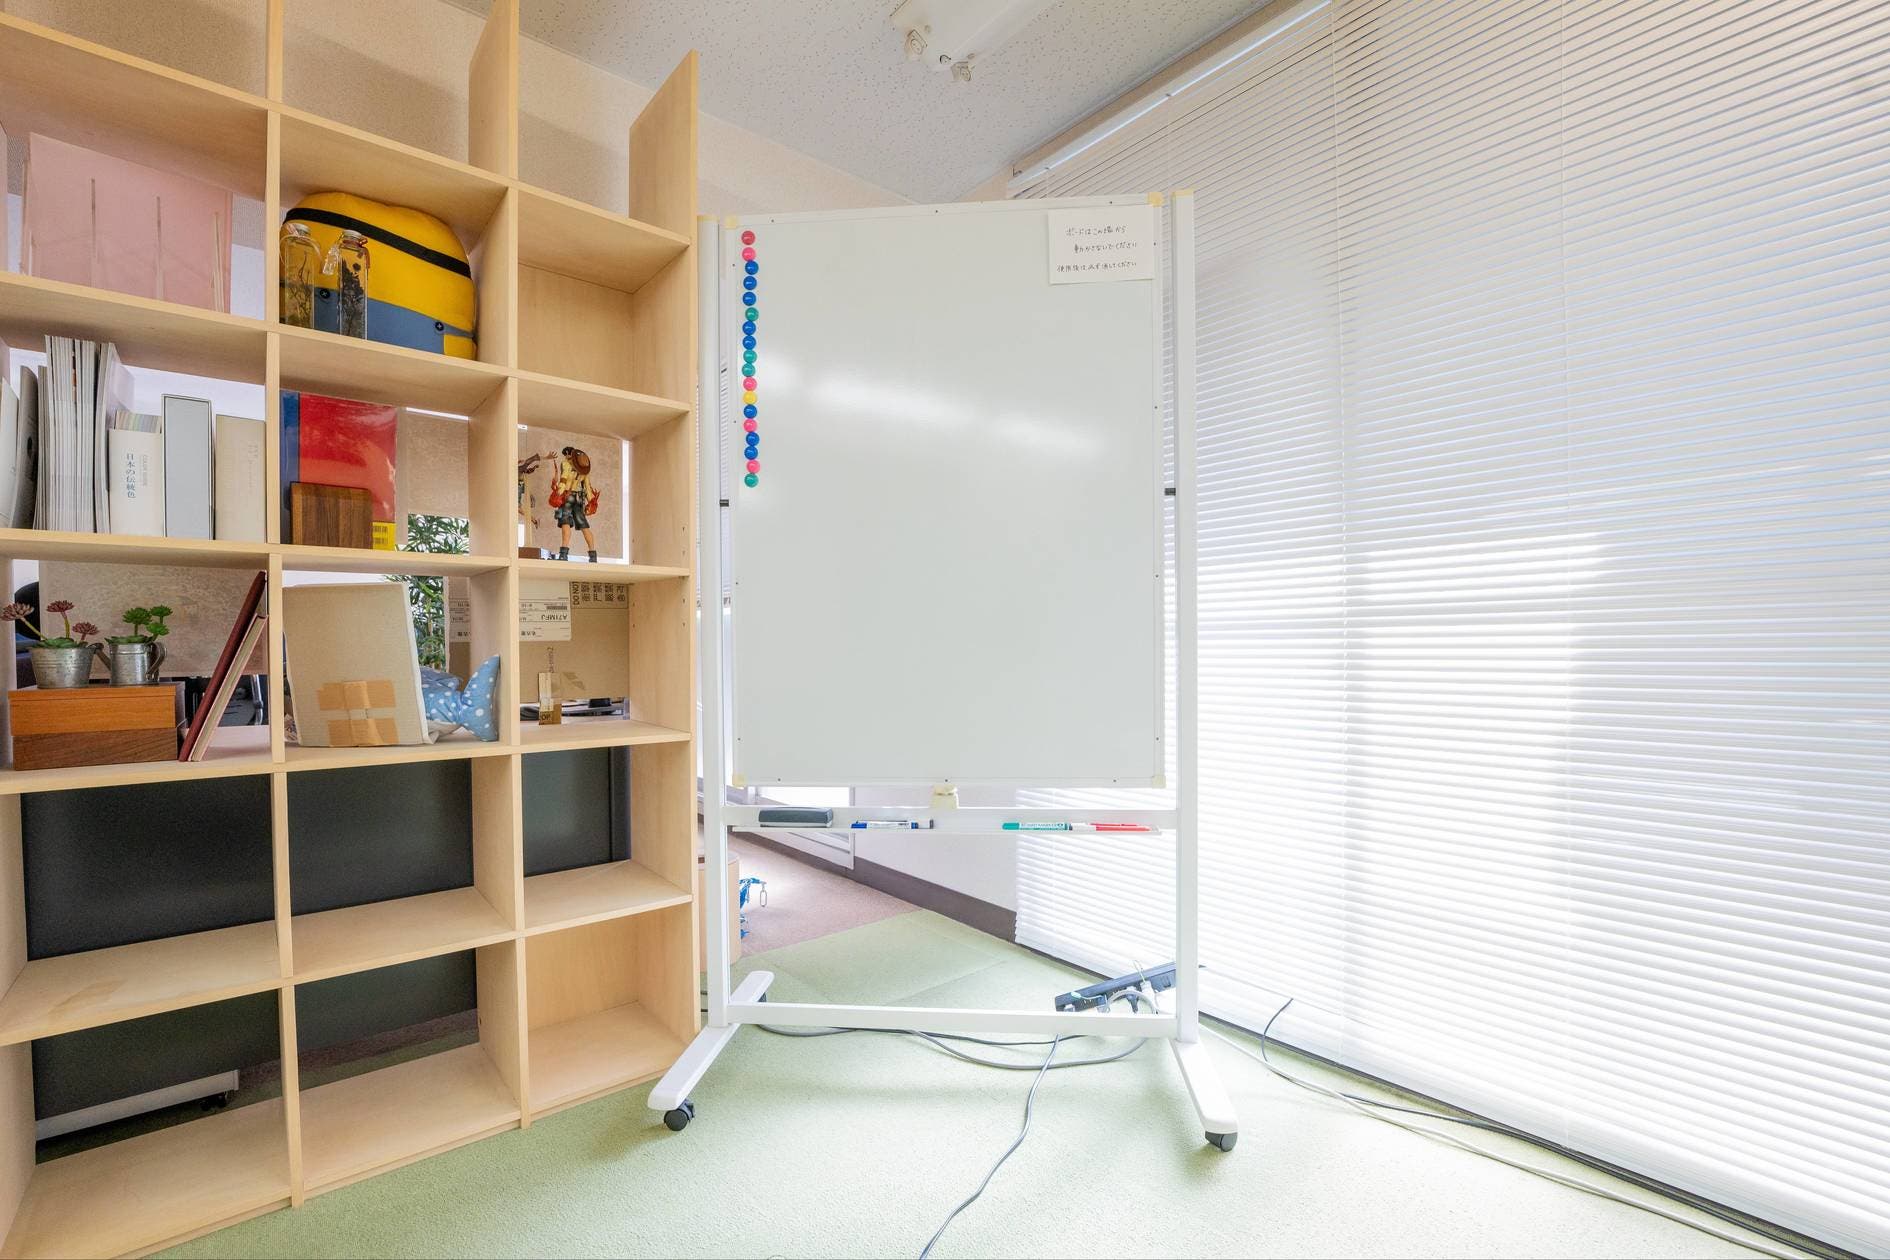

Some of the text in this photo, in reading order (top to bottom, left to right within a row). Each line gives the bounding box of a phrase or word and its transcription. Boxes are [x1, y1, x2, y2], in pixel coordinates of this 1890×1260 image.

[126, 453, 136, 498] 日本の伝統色
